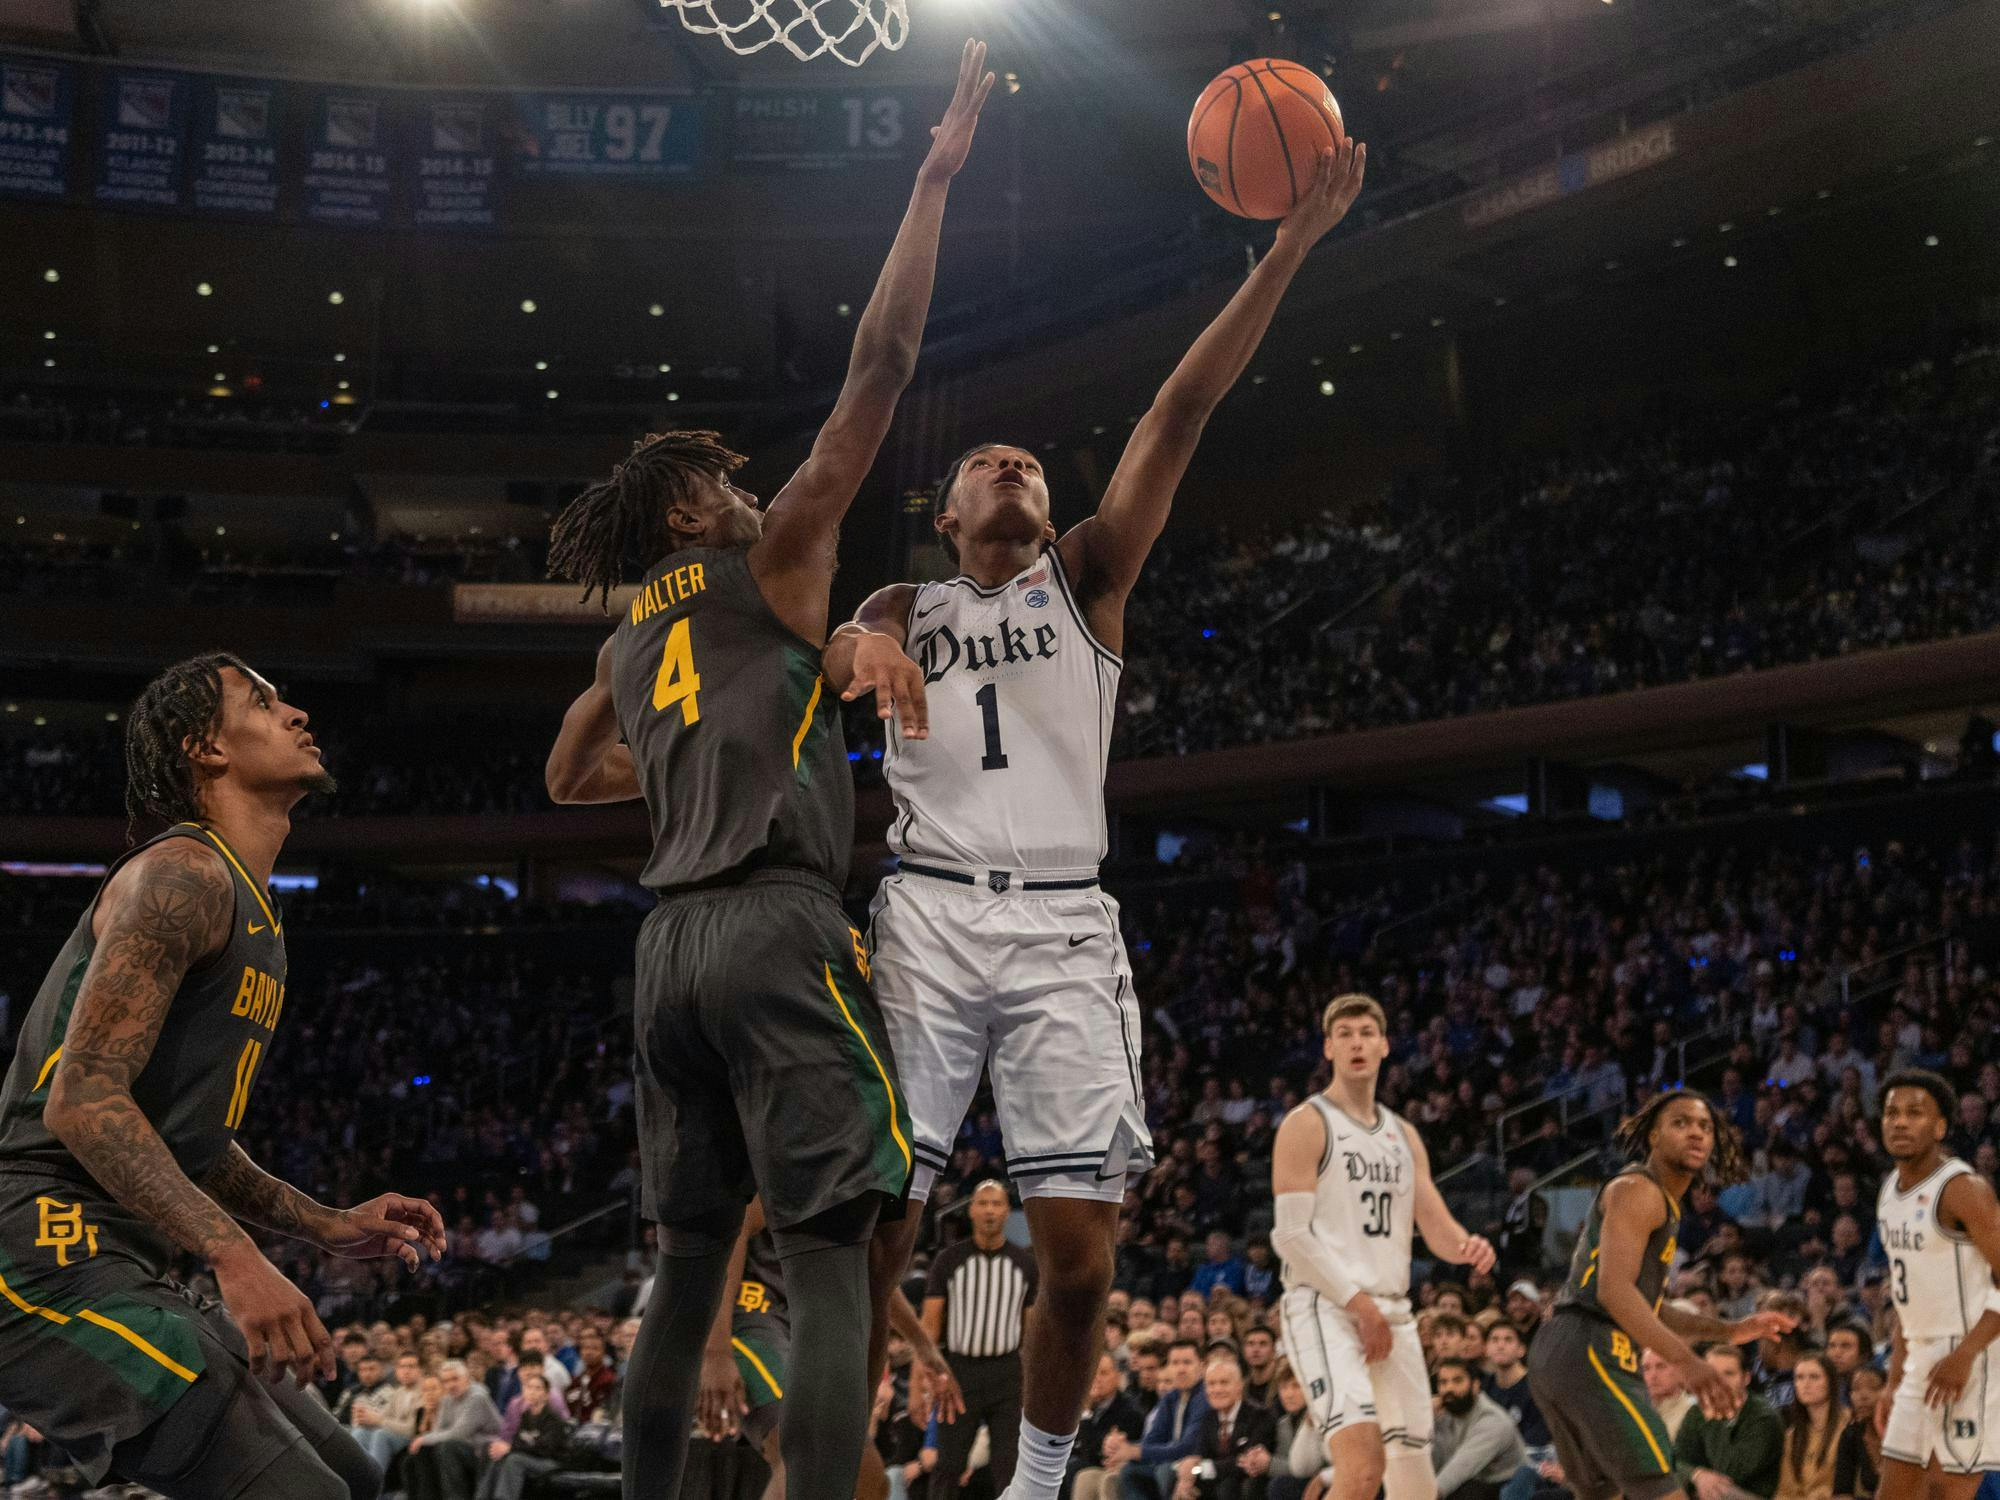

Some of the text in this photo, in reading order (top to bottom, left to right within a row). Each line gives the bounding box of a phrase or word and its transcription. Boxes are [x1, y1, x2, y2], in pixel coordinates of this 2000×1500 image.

[547, 103, 599, 130] BILLY
[605, 104, 671, 161] 97
[736, 96, 818, 118] PHISH
[842, 97, 902, 147] 13
[632, 562, 707, 626] WALTER
[652, 616, 701, 727] 4
[917, 617, 1058, 687] Duke
[975, 683, 1009, 771] 1
[224, 1038, 262, 1130] 11
[1360, 1190, 1393, 1238] 30
[1894, 1258, 1908, 1305] 3
